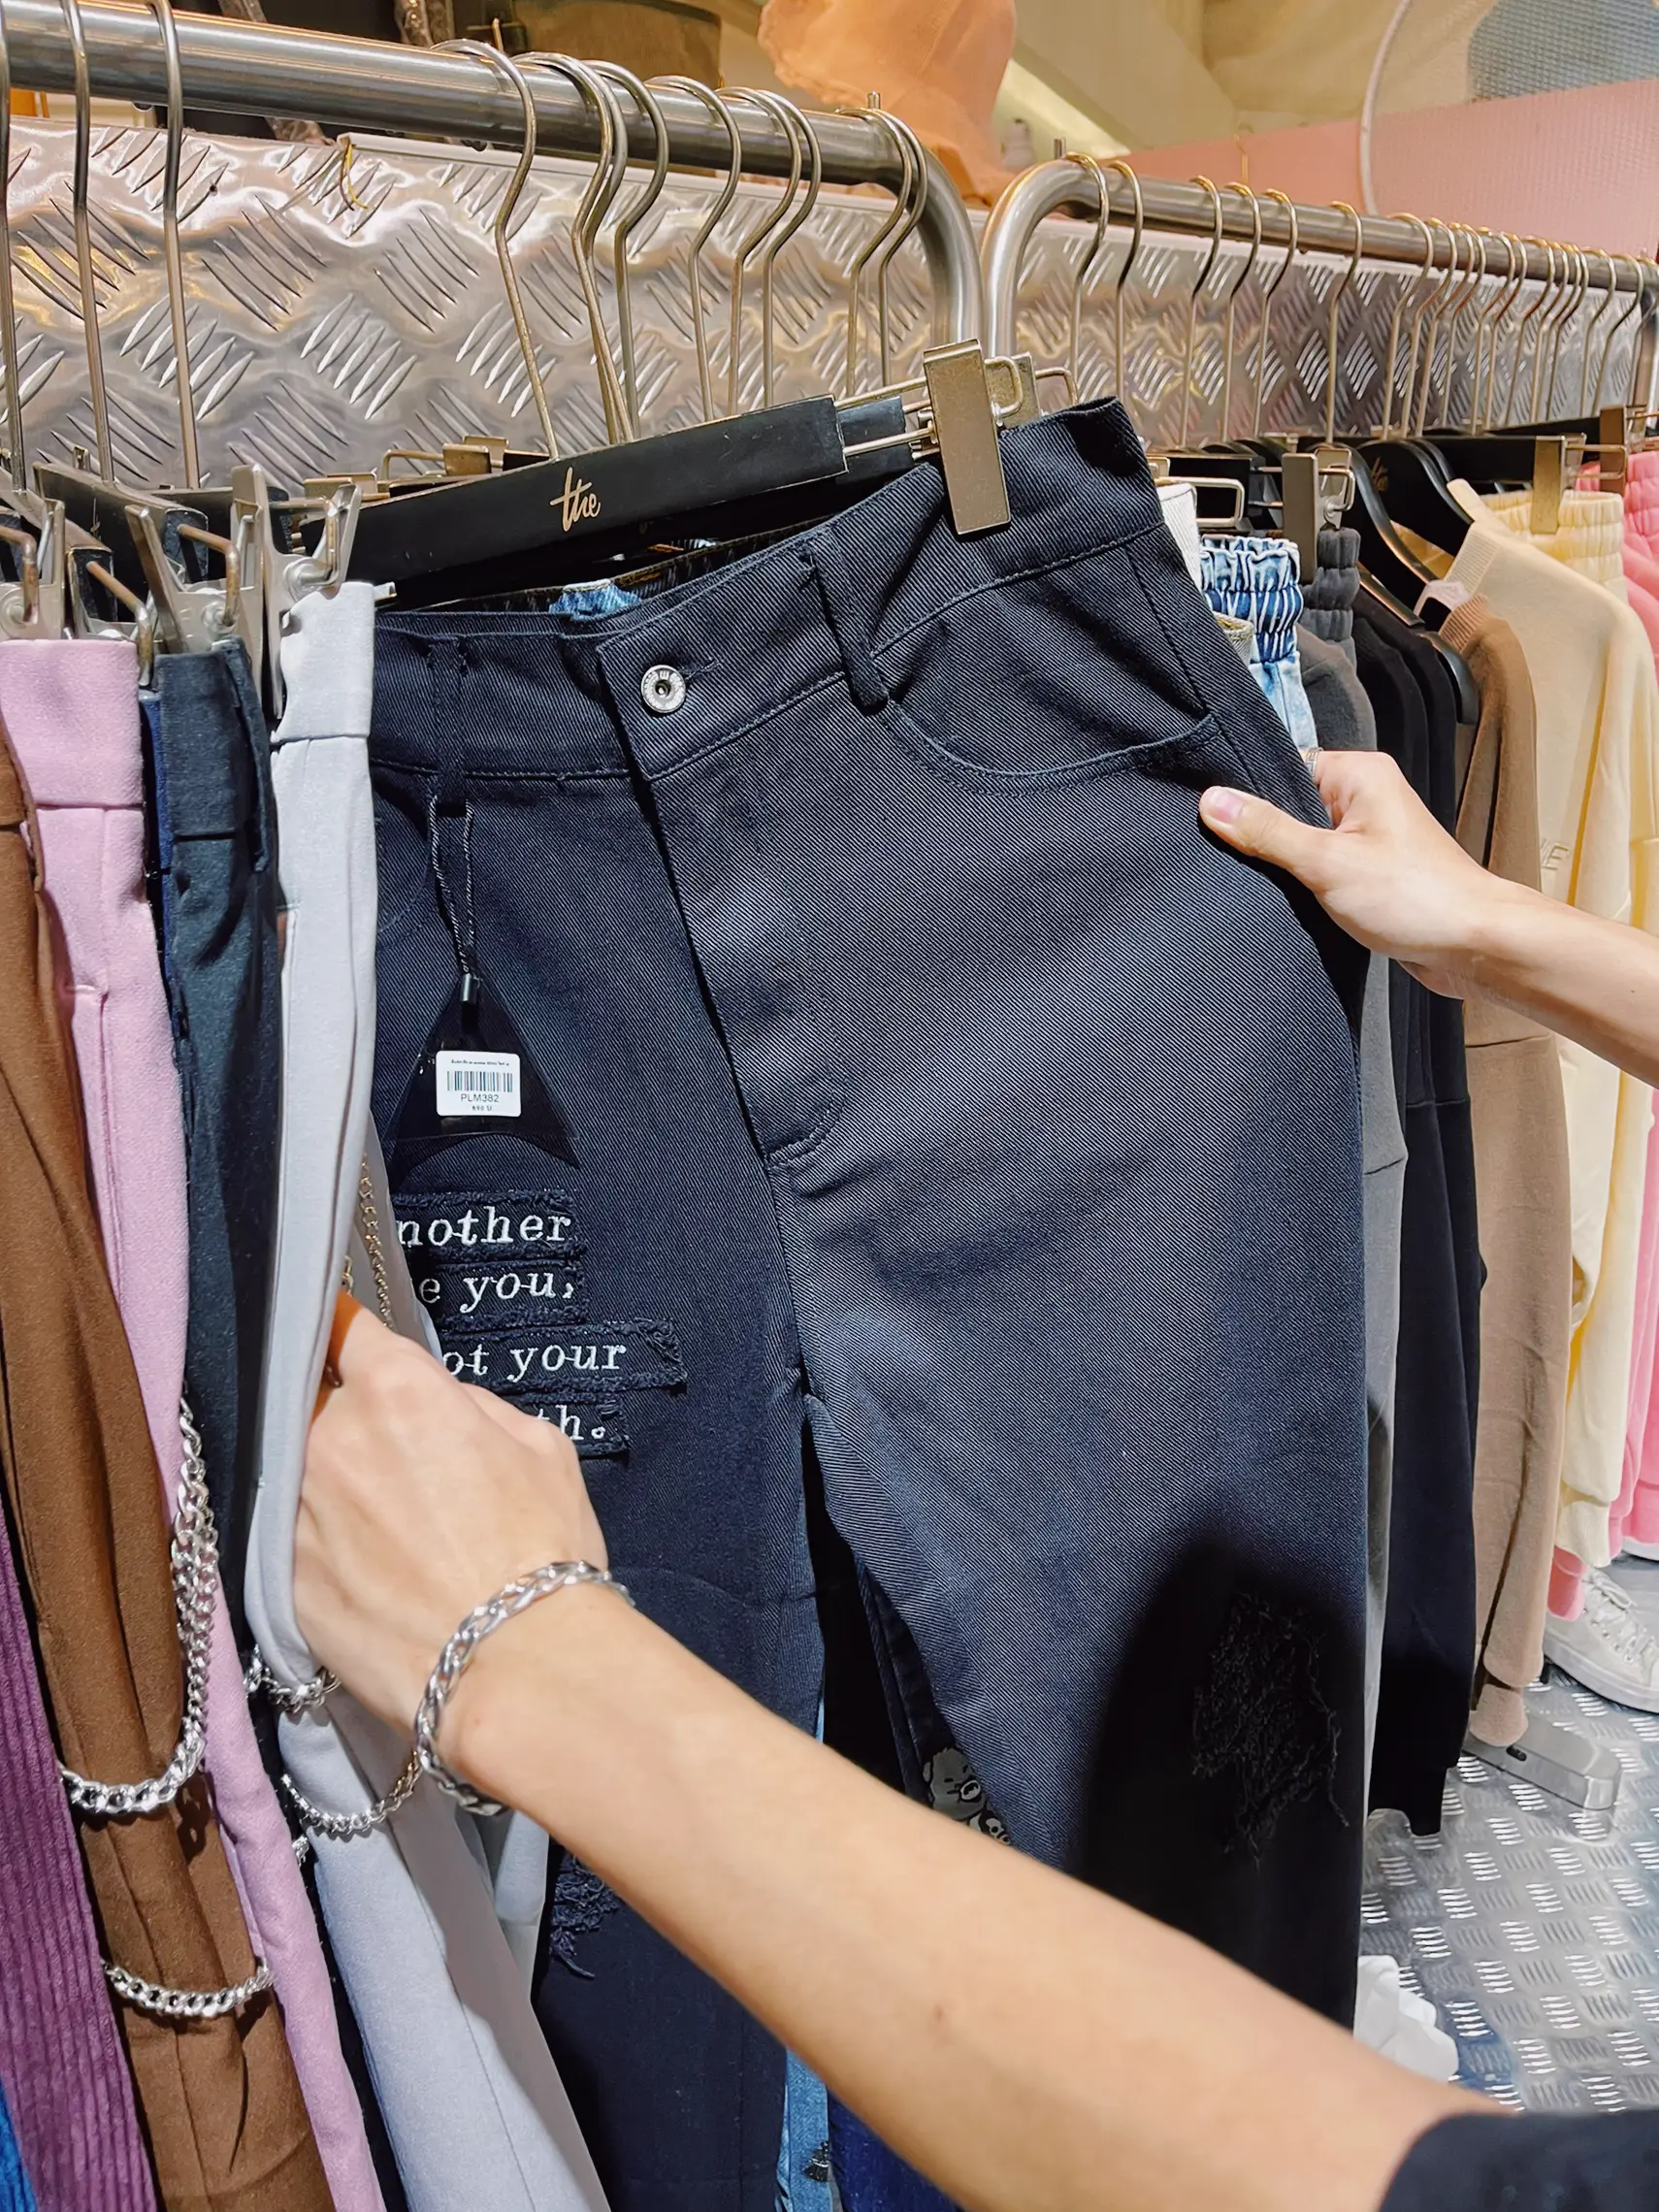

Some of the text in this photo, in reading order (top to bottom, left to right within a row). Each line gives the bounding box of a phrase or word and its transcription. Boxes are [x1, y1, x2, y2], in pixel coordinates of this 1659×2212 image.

[460, 1092, 500, 1103] PLM382
[459, 1272, 574, 1314] you,
[506, 1343, 628, 1383] your
